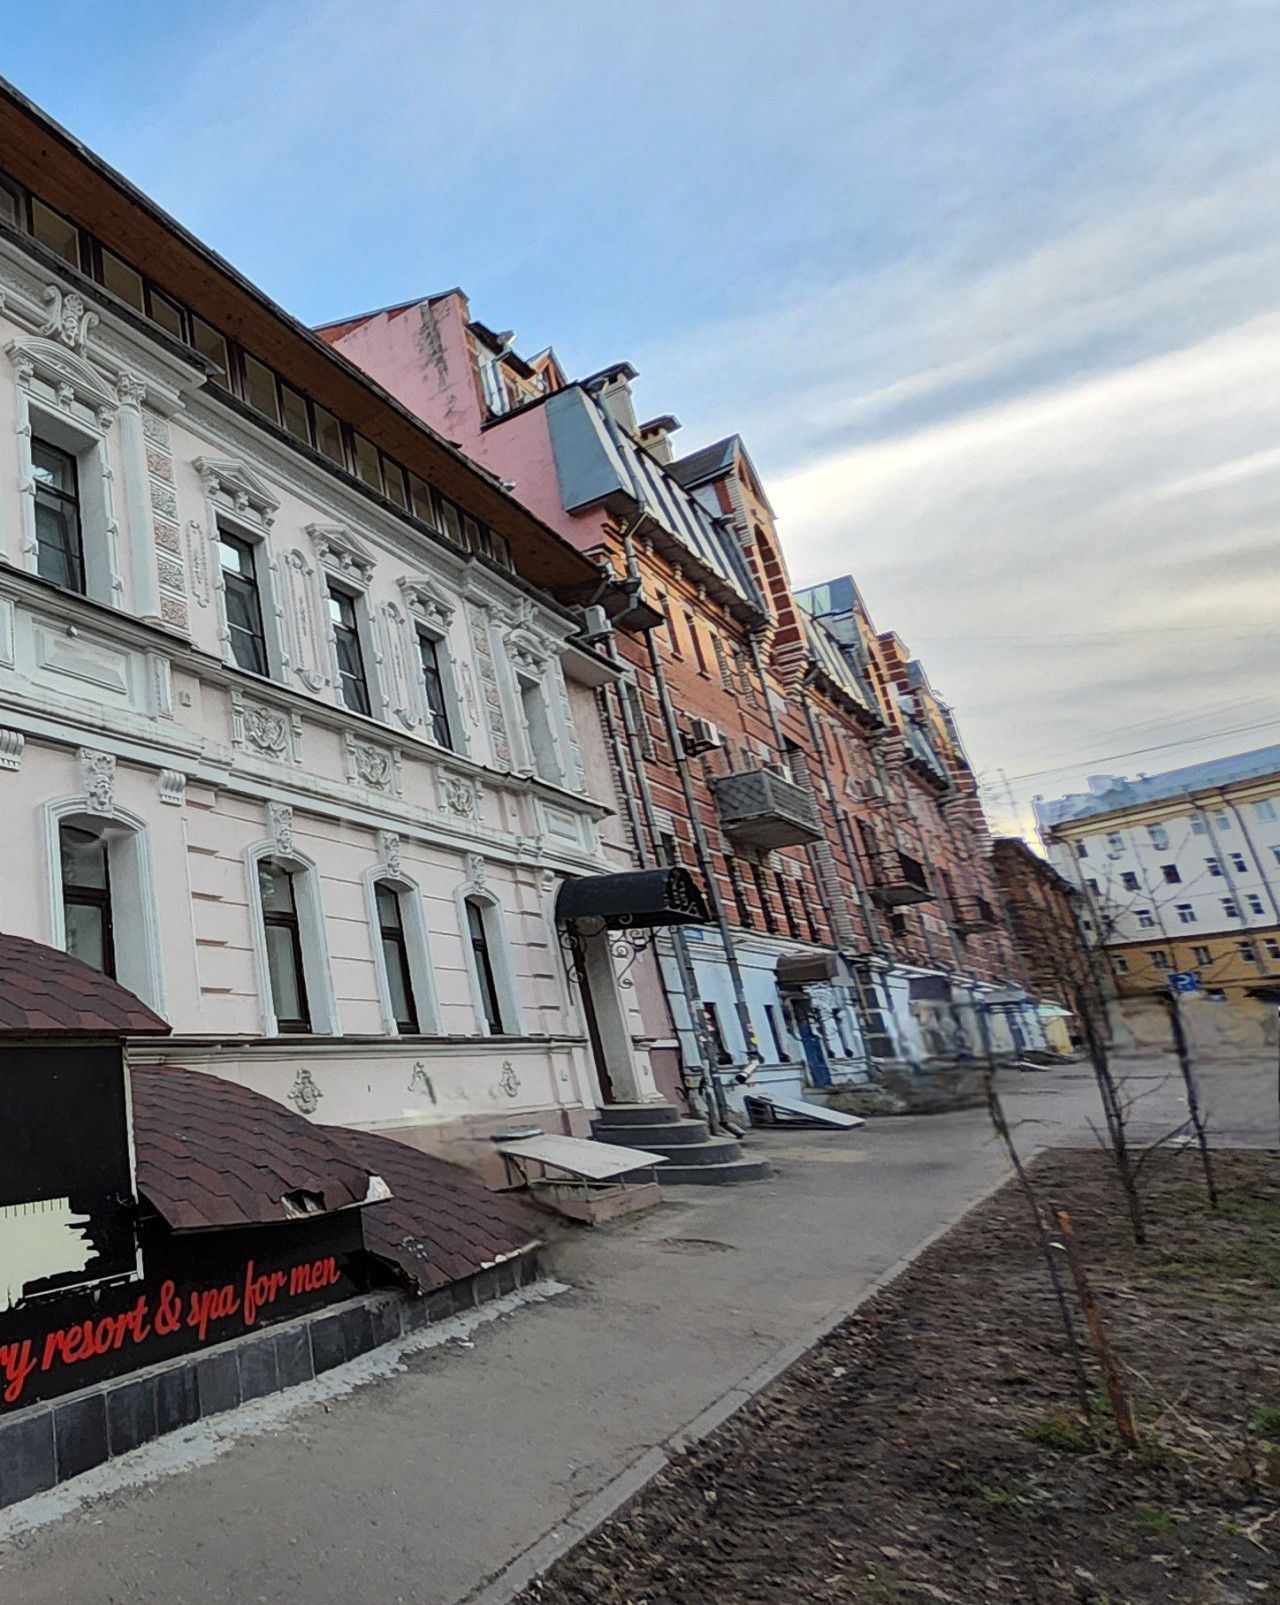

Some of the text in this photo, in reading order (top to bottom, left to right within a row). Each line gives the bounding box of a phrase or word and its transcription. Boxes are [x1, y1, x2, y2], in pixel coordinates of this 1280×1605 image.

[41, 1295, 151, 1371] resort
[154, 1279, 181, 1336] &
[187, 1285, 240, 1341] spa
[244, 1260, 287, 1326] for
[290, 1256, 341, 1296] men
